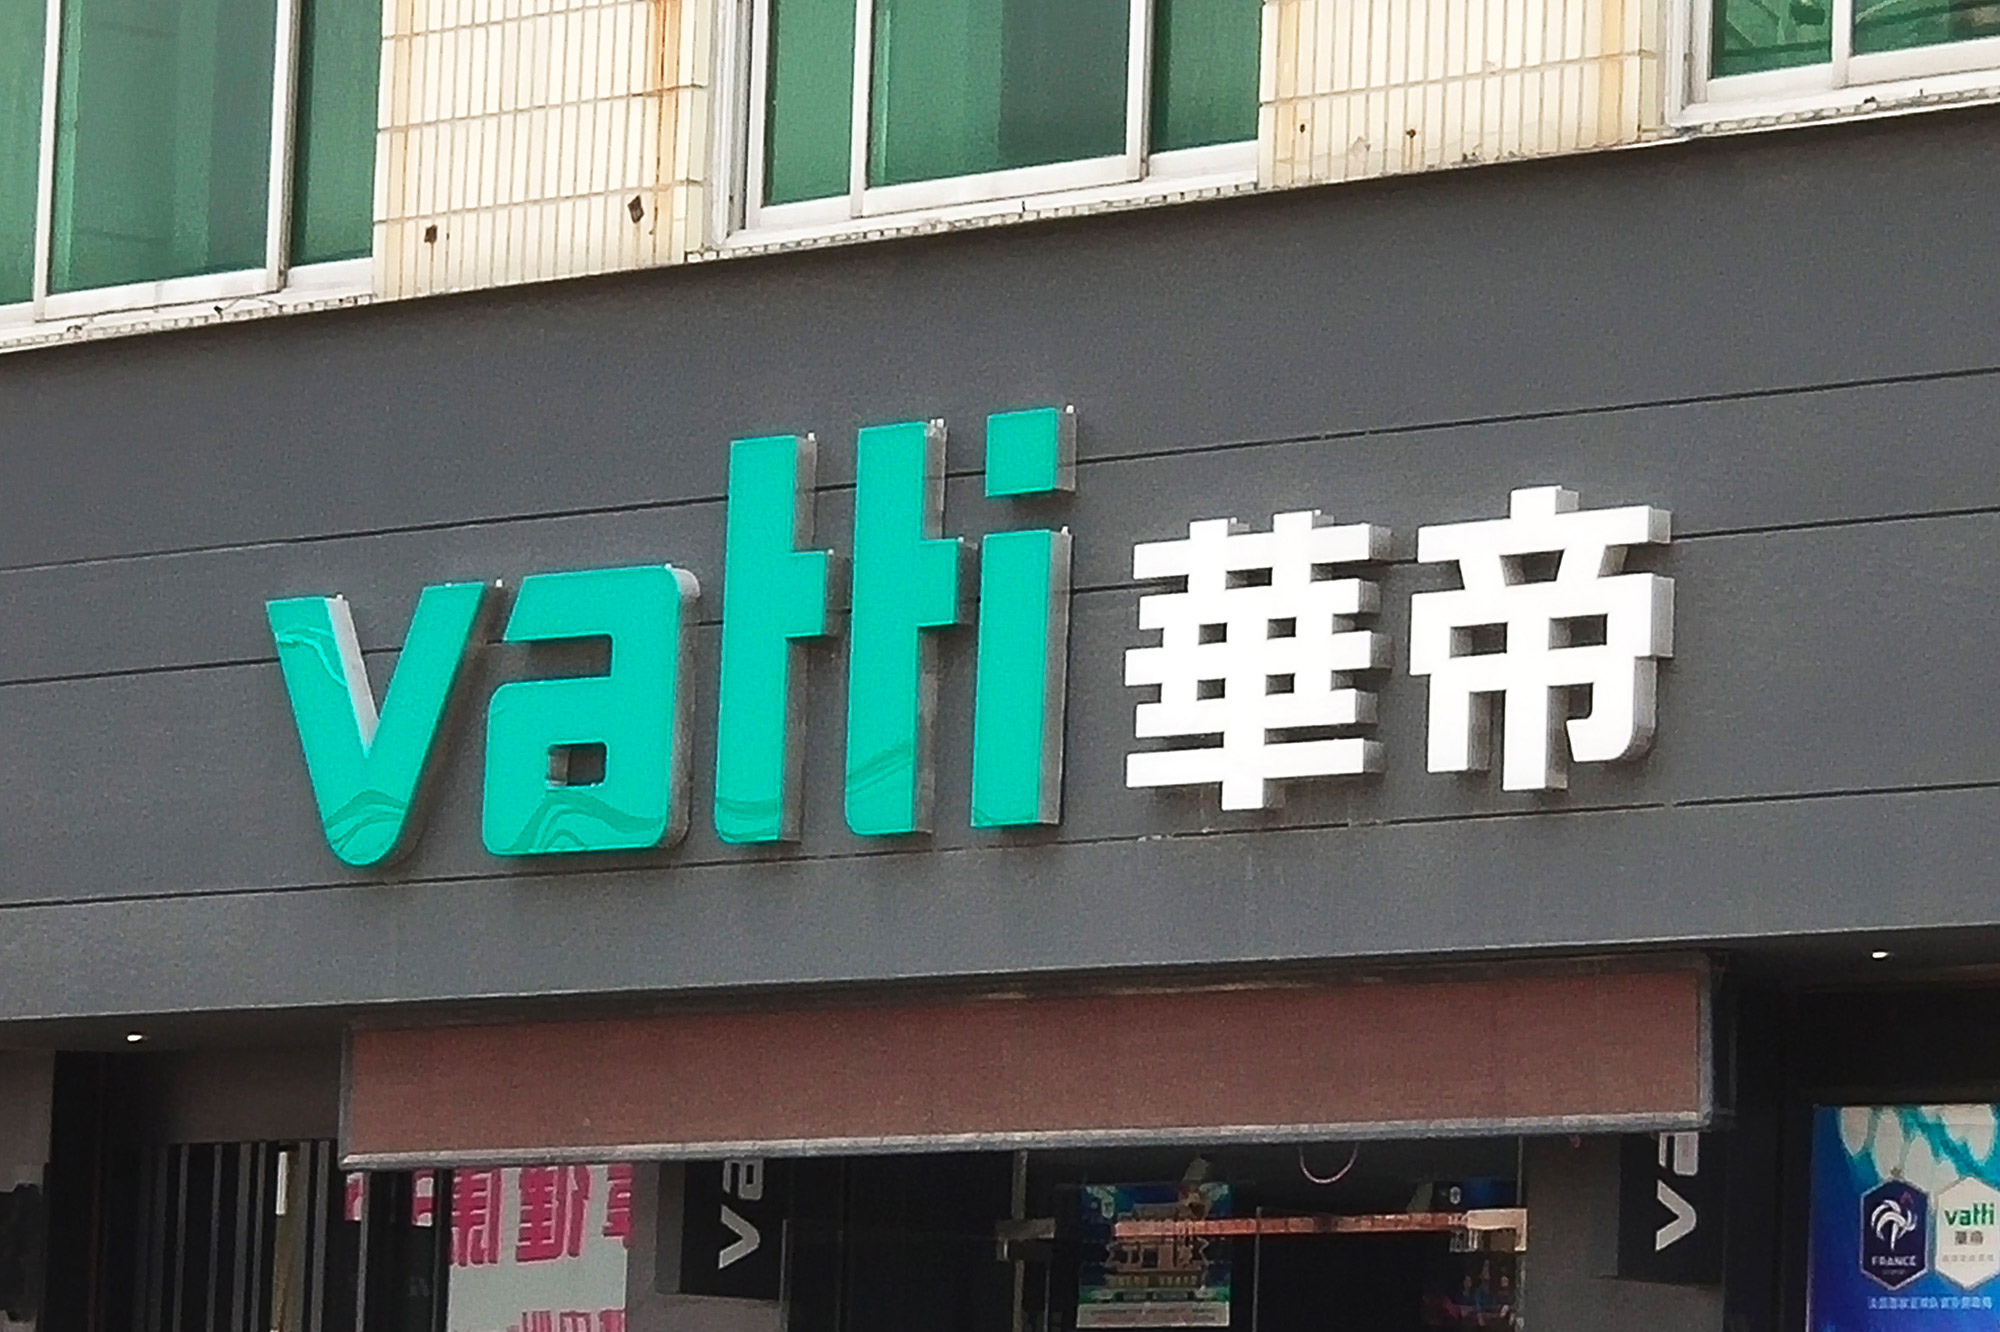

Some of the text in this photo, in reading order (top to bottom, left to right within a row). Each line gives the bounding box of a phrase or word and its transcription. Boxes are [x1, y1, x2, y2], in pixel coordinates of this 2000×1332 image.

[266, 405, 1673, 867] vatti 華帝
[1944, 1203, 1995, 1226] vatti
[1871, 1255, 1917, 1267] FRANCE
